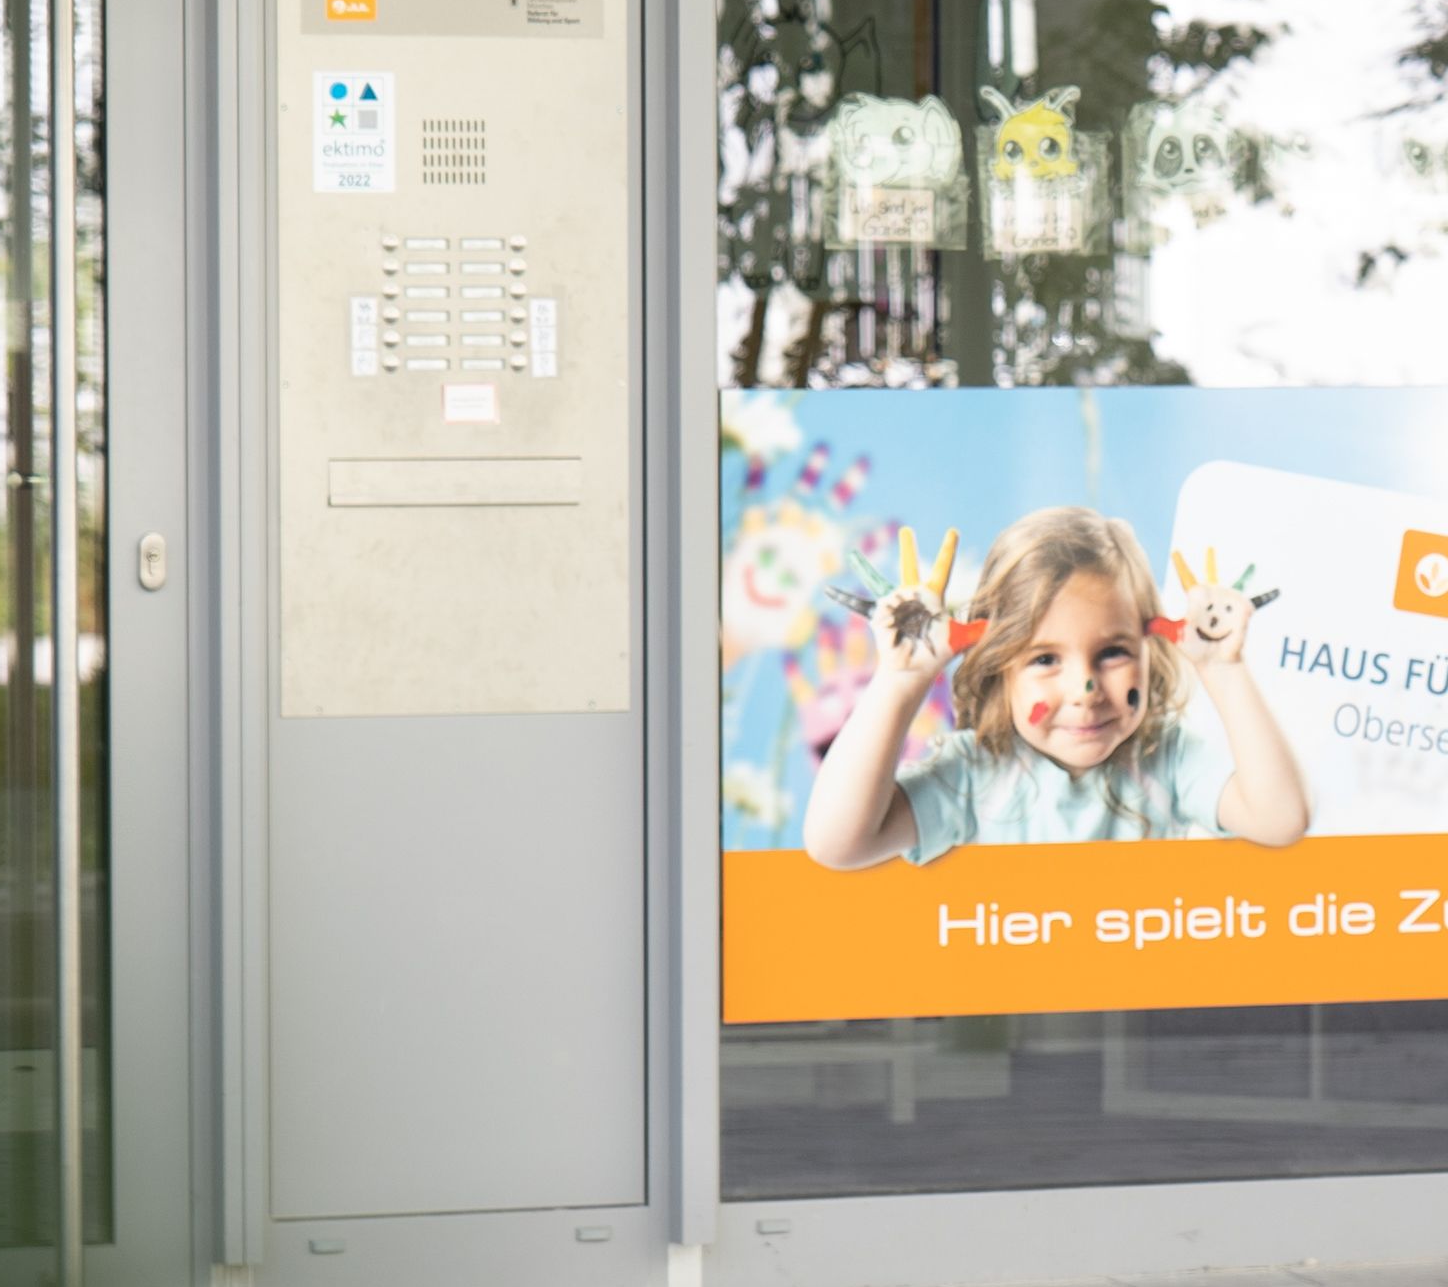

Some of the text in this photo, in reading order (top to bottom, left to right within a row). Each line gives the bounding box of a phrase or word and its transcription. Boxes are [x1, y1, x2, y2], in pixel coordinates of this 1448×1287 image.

[338, 174, 371, 187] 2022
[1279, 636, 1391, 687] HAUS
[938, 901, 1072, 947] Hier
[1094, 895, 1267, 951] spielt
[1287, 892, 1376, 938] die
